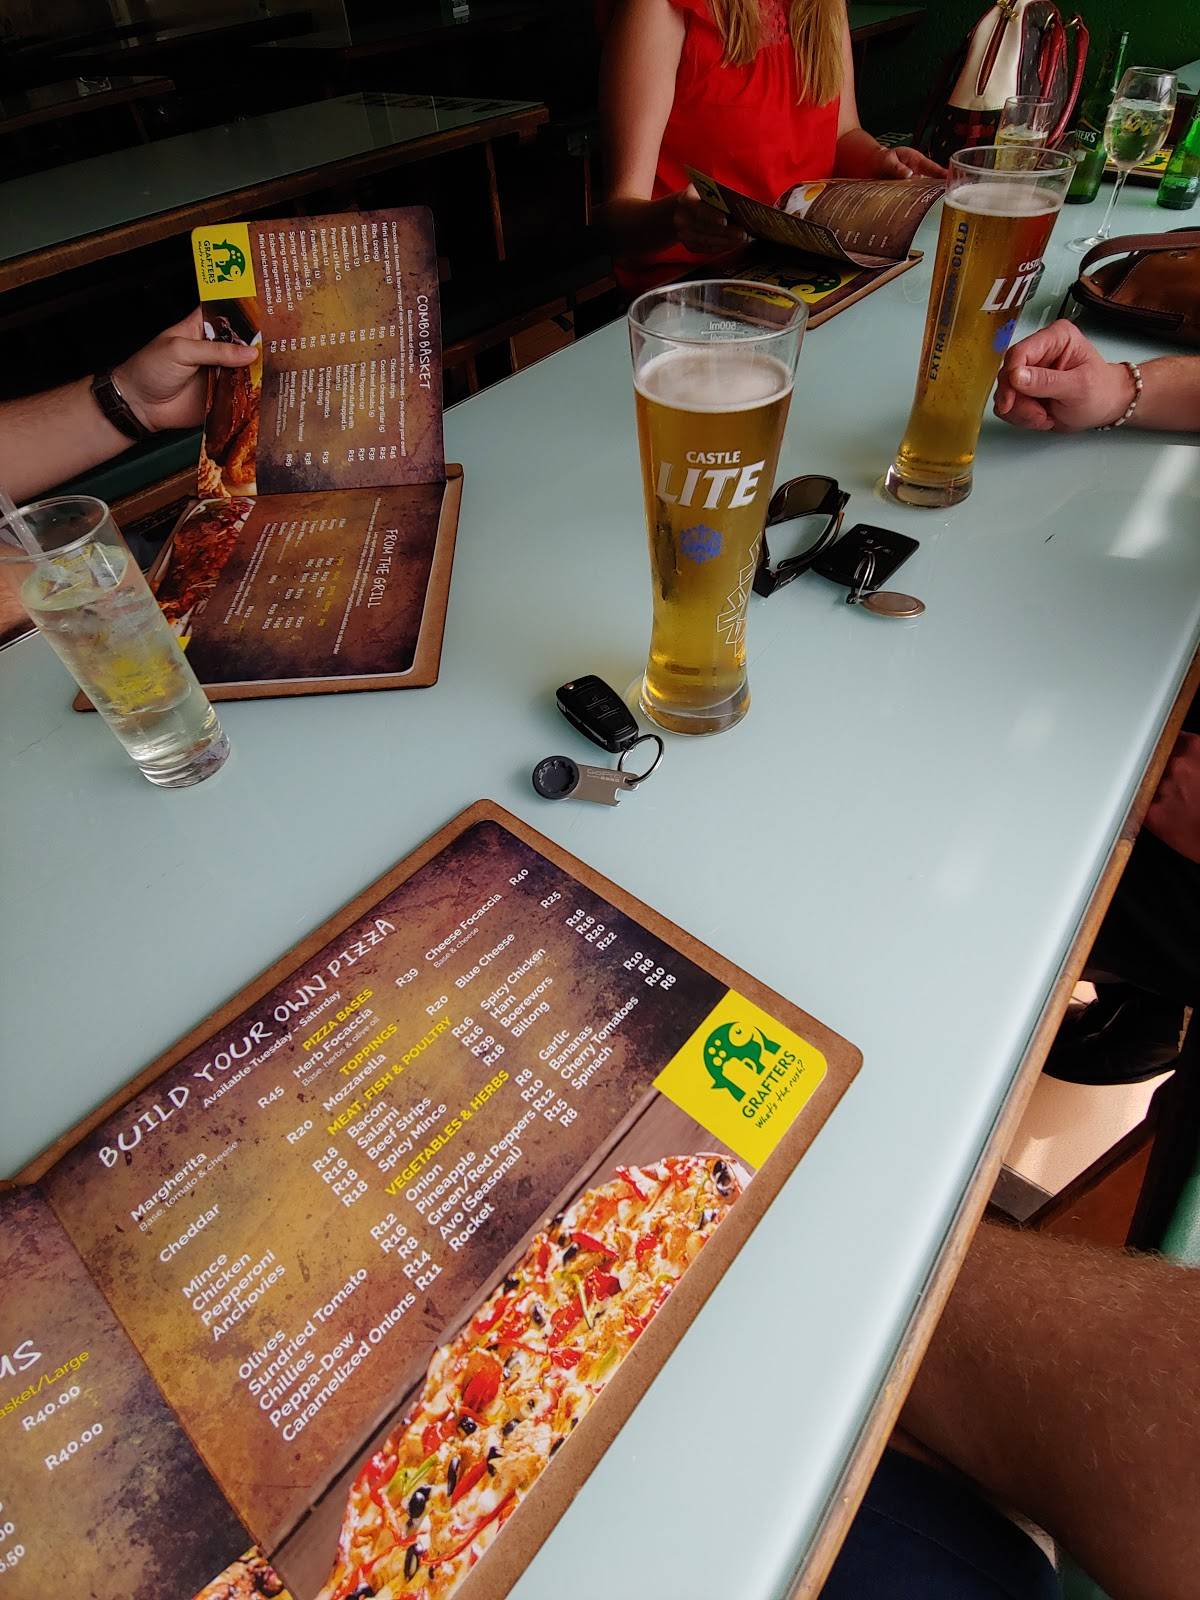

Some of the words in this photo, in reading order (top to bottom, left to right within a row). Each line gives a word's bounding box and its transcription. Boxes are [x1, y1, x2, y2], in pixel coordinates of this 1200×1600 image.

[202, 240, 216, 283] GRAFTERS
[416, 295, 429, 337] COMBO
[417, 341, 432, 389] BASKET
[929, 331, 946, 381] EXTRA
[656, 459, 766, 509] LITE
[686, 450, 741, 465] CASTLE
[367, 577, 386, 608] GRILL
[375, 556, 391, 574] THE
[381, 529, 398, 553] FROM
[424, 928, 462, 960] Cheese
[459, 893, 502, 929] Focaccia
[508, 868, 529, 886] R40
[454, 965, 481, 988] Blue
[478, 933, 516, 966] Cheese
[540, 890, 562, 908] R25
[479, 982, 511, 1011] Spicy
[506, 947, 546, 984] Chicken
[565, 908, 586, 926] R18
[489, 994, 517, 1018] Ham
[574, 915, 596, 934] R16
[292, 1050, 324, 1077] Herb
[322, 1007, 373, 1051] Focaccia
[395, 967, 419, 987] R39
[302, 1019, 338, 1050] PIZZA
[335, 988, 373, 1021] BASES
[499, 976, 554, 1027] Boerewors
[584, 923, 606, 942] R20
[510, 1000, 551, 1037] Biltong
[596, 931, 618, 950] R22
[537, 1028, 571, 1060] Garlic
[622, 950, 644, 970] R10
[548, 1025, 594, 1070] Bananas
[637, 958, 655, 974] R8
[559, 1043, 597, 1080] Cherry
[589, 995, 640, 1045] Tomatoes
[644, 966, 666, 986] R10
[569, 1045, 615, 1090] Spinach
[659, 974, 677, 990] R8
[97, 1084, 191, 1168] BUILD
[193, 1020, 272, 1085] YOUR
[271, 973, 328, 1023] OWN
[325, 917, 395, 977] PIZZA
[202, 1065, 251, 1107] Available
[249, 1031, 293, 1068] Tuesday
[298, 990, 341, 1027] Saturday
[321, 1052, 387, 1111] Mozzarella
[425, 994, 449, 1016] R20
[326, 1098, 367, 1135] MEAT,
[363, 1071, 394, 1100] FISH
[390, 1061, 405, 1075] &
[400, 1016, 452, 1065] POULTRY
[339, 1023, 398, 1075] TOPPINGS
[346, 1100, 388, 1138] Bacon
[450, 1015, 474, 1037] R16
[356, 1106, 400, 1149] Salami
[460, 1024, 484, 1046] R16
[365, 1127, 398, 1160] Beef
[394, 1096, 432, 1132] Strips
[470, 1034, 496, 1057] R39
[741, 1050, 797, 1119] GRAFTERS
[777, 1085, 791, 1103] the
[130, 1151, 207, 1222] Margherita
[257, 1084, 284, 1109] R45
[377, 1136, 414, 1173] Spicy
[409, 1102, 448, 1139] Mince
[482, 1043, 506, 1066] R18
[383, 1117, 464, 1196] VEGETABLES
[458, 1106, 473, 1122] &
[469, 1069, 510, 1110] HERBS
[404, 1162, 444, 1201] Onion
[514, 1068, 533, 1086] R8
[414, 1150, 478, 1214] Pineapple
[520, 1078, 544, 1102] R10
[425, 1153, 495, 1226] Green/Red
[489, 1109, 538, 1158] Peppers
[531, 1088, 556, 1111] R12
[158, 1203, 220, 1262] Cheddar
[286, 1118, 313, 1144] R20
[182, 1252, 228, 1298] Mince
[312, 1146, 339, 1172] R18
[438, 1210, 465, 1240] Avo
[459, 1145, 524, 1213] (Seasonal)
[543, 1097, 568, 1122] R15
[448, 1201, 496, 1252] Rocket
[558, 1107, 578, 1127] R8
[191, 1252, 252, 1311] Chicken
[321, 1157, 348, 1184] R16
[199, 1248, 277, 1327] Pepperoni
[331, 1168, 359, 1195] R18
[210, 1263, 287, 1341] Anchovies
[341, 1179, 369, 1207] R18
[237, 1328, 286, 1380] Olives
[370, 1212, 397, 1240] R12
[247, 1320, 318, 1396] Sundried
[312, 1266, 369, 1324] Tomato
[380, 1223, 408, 1253] R16
[258, 1348, 316, 1411] Chillies
[397, 1235, 419, 1259] R8
[268, 1331, 357, 1429] Peppa-Dew
[402, 1249, 431, 1279] R14
[280, 1340, 373, 1442] Caramelized
[367, 1291, 417, 1344] Onions
[414, 1262, 443, 1291] R11
[22, 1385, 81, 1432] R40.00
[44, 1423, 104, 1471] R40.00
